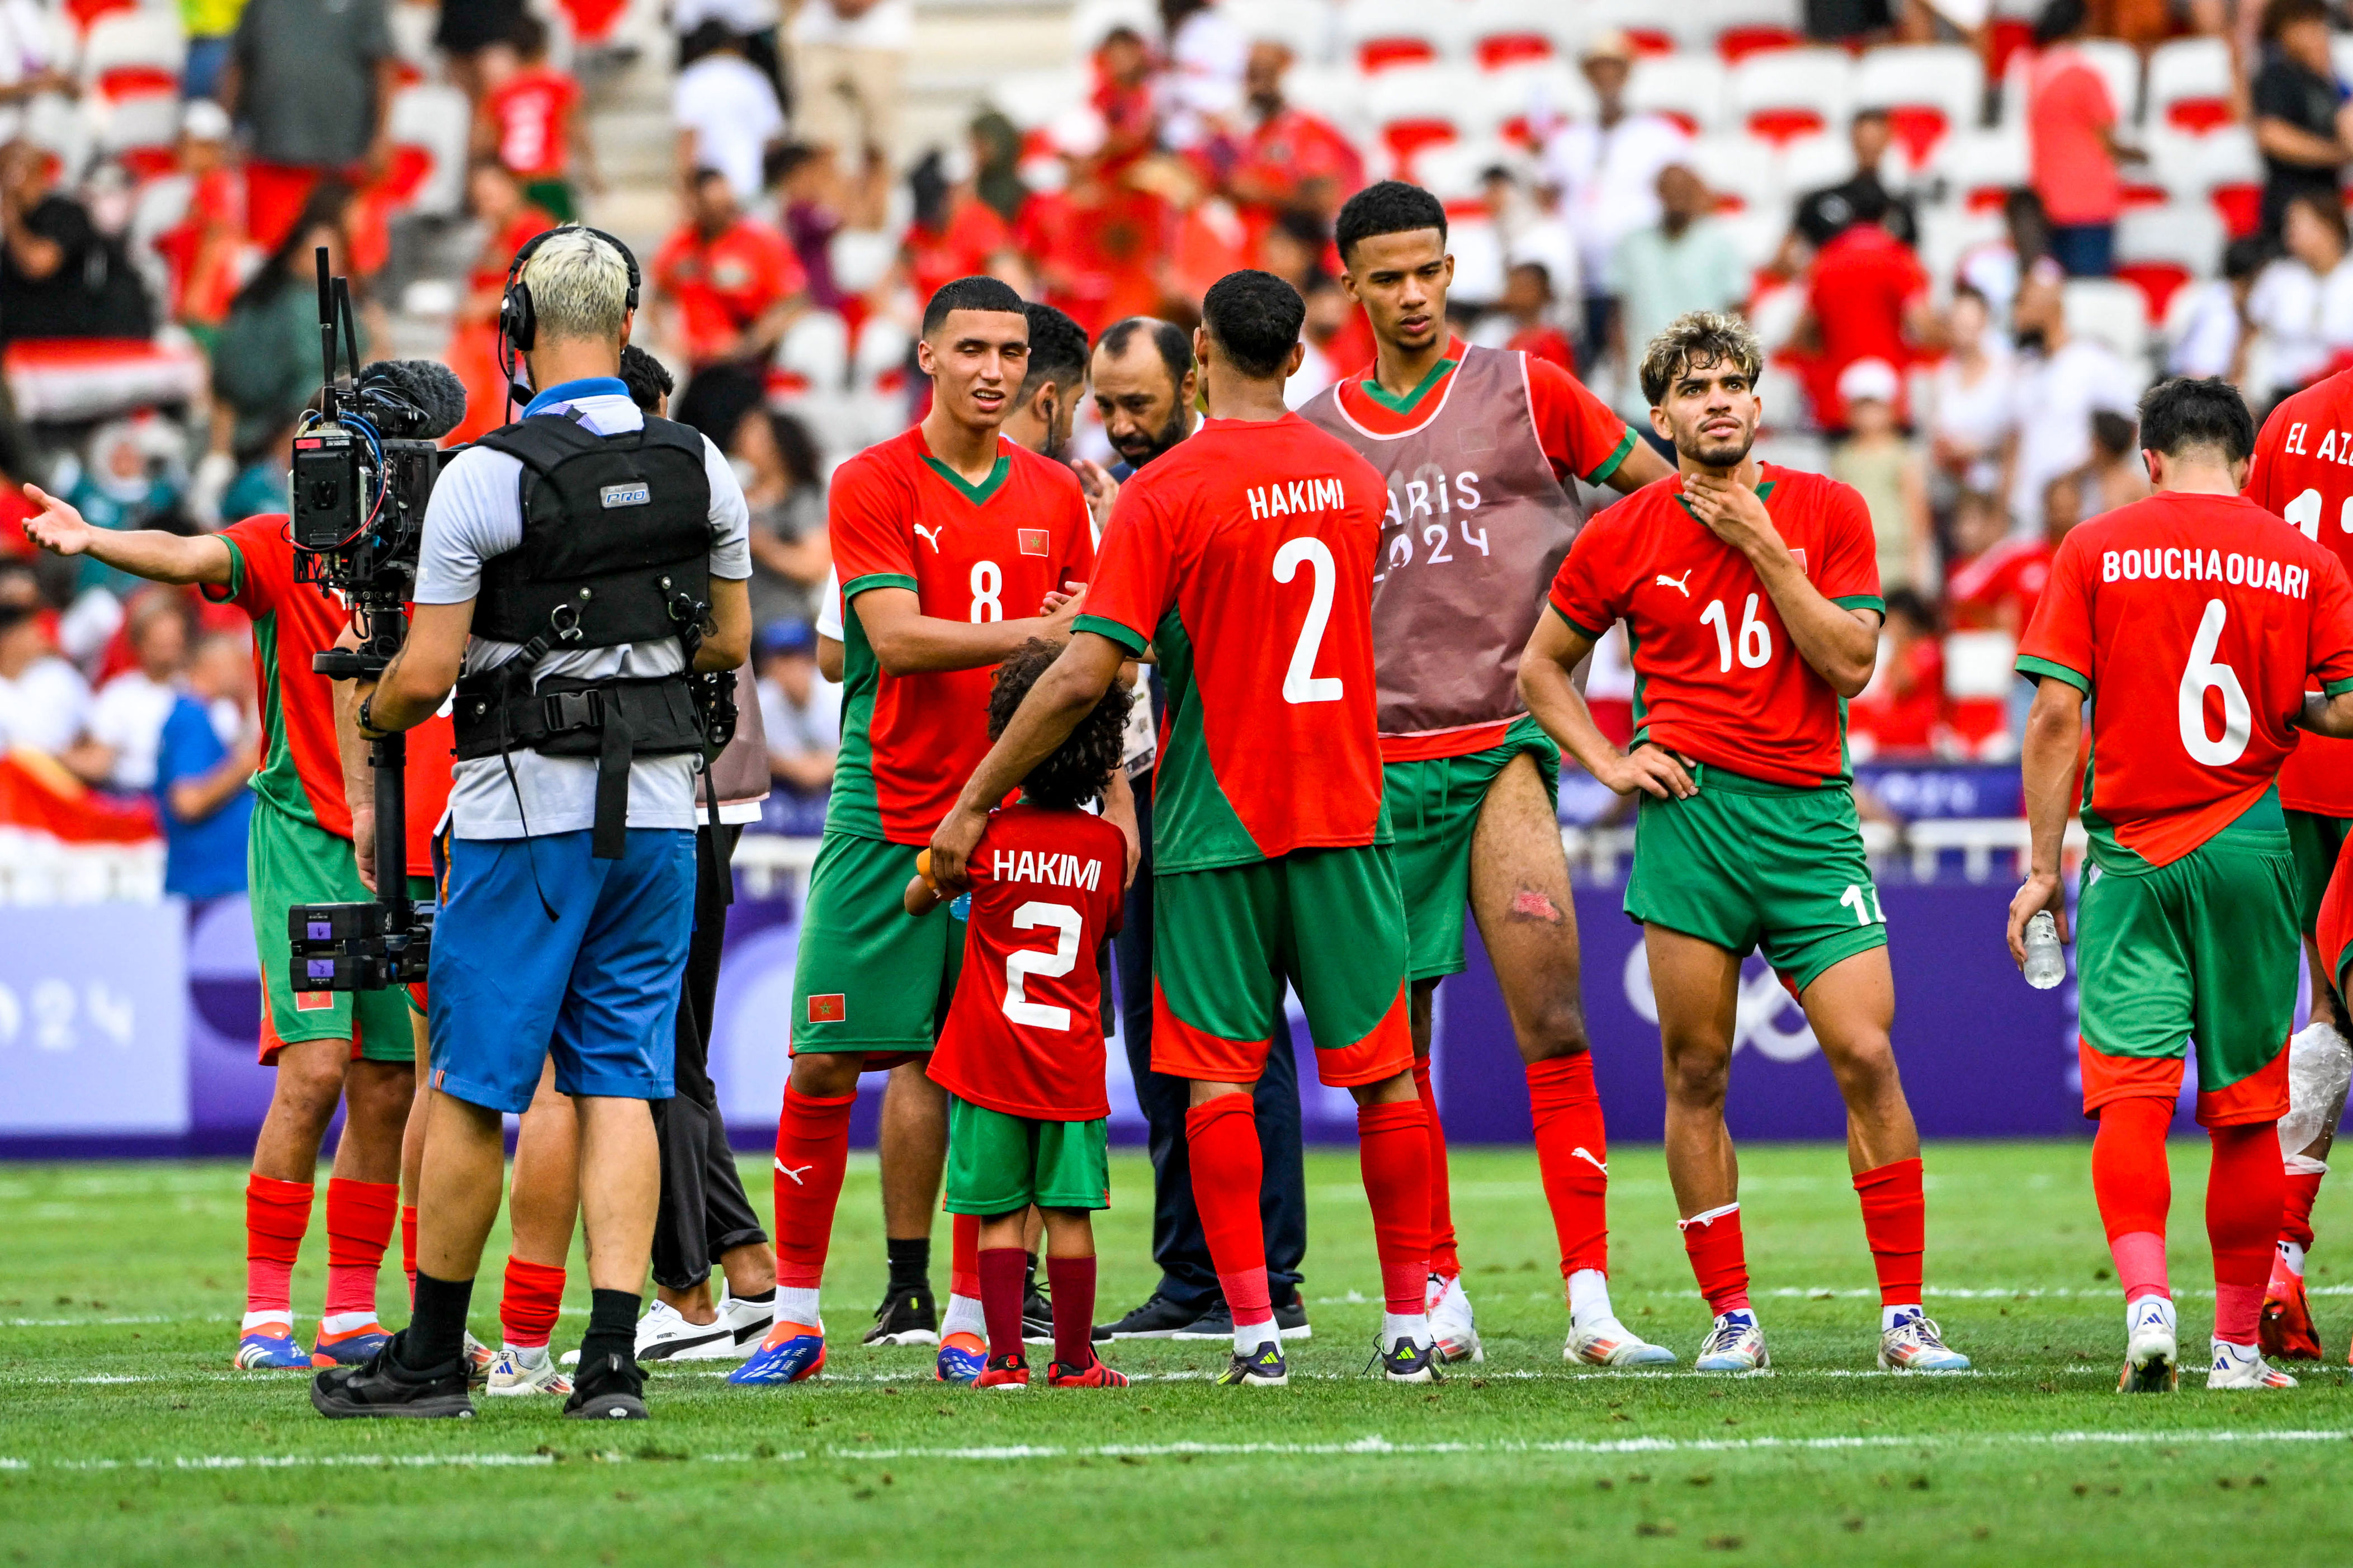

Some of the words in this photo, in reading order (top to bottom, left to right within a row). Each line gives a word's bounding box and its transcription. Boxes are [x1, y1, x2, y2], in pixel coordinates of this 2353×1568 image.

[2285, 423, 2308, 455] EL
[605, 489, 646, 504] PRO
[1247, 478, 1344, 520] HAKIMI
[2284, 488, 2353, 542] 1
[1373, 520, 1490, 583] 024
[2102, 547, 2309, 599] BOUCHAOUARI
[970, 560, 1004, 625] 8
[1272, 536, 1343, 704] 2
[1699, 593, 1772, 673] 16
[2179, 598, 2251, 766] 6
[994, 849, 1102, 892] HAKIMI
[1002, 901, 1083, 1031] 2
